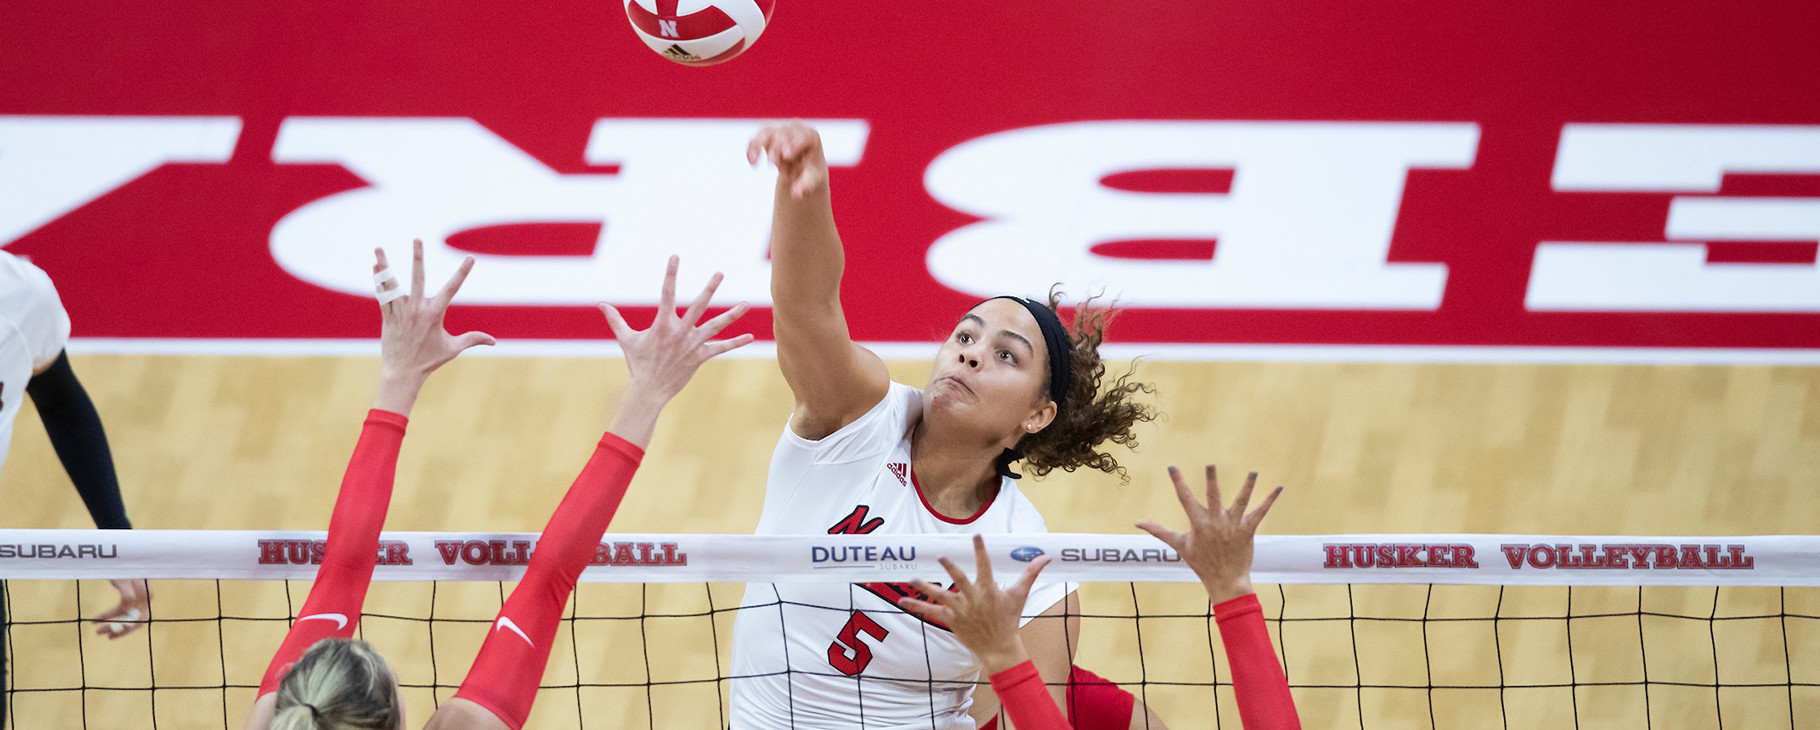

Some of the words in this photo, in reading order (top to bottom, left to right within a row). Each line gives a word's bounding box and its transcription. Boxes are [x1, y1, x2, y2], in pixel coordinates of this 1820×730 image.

[659, 19, 679, 37] N
[887, 463, 907, 487] adidas
[0, 544, 117, 559] SUBARU
[435, 540, 687, 566] VOLLBALL
[811, 546, 916, 562] DUTEAU
[1060, 548, 1181, 562] SUBARU
[1323, 543, 1479, 568] HUSKER
[1501, 543, 1754, 569] VOLLEYBALL
[827, 609, 889, 676] 5
